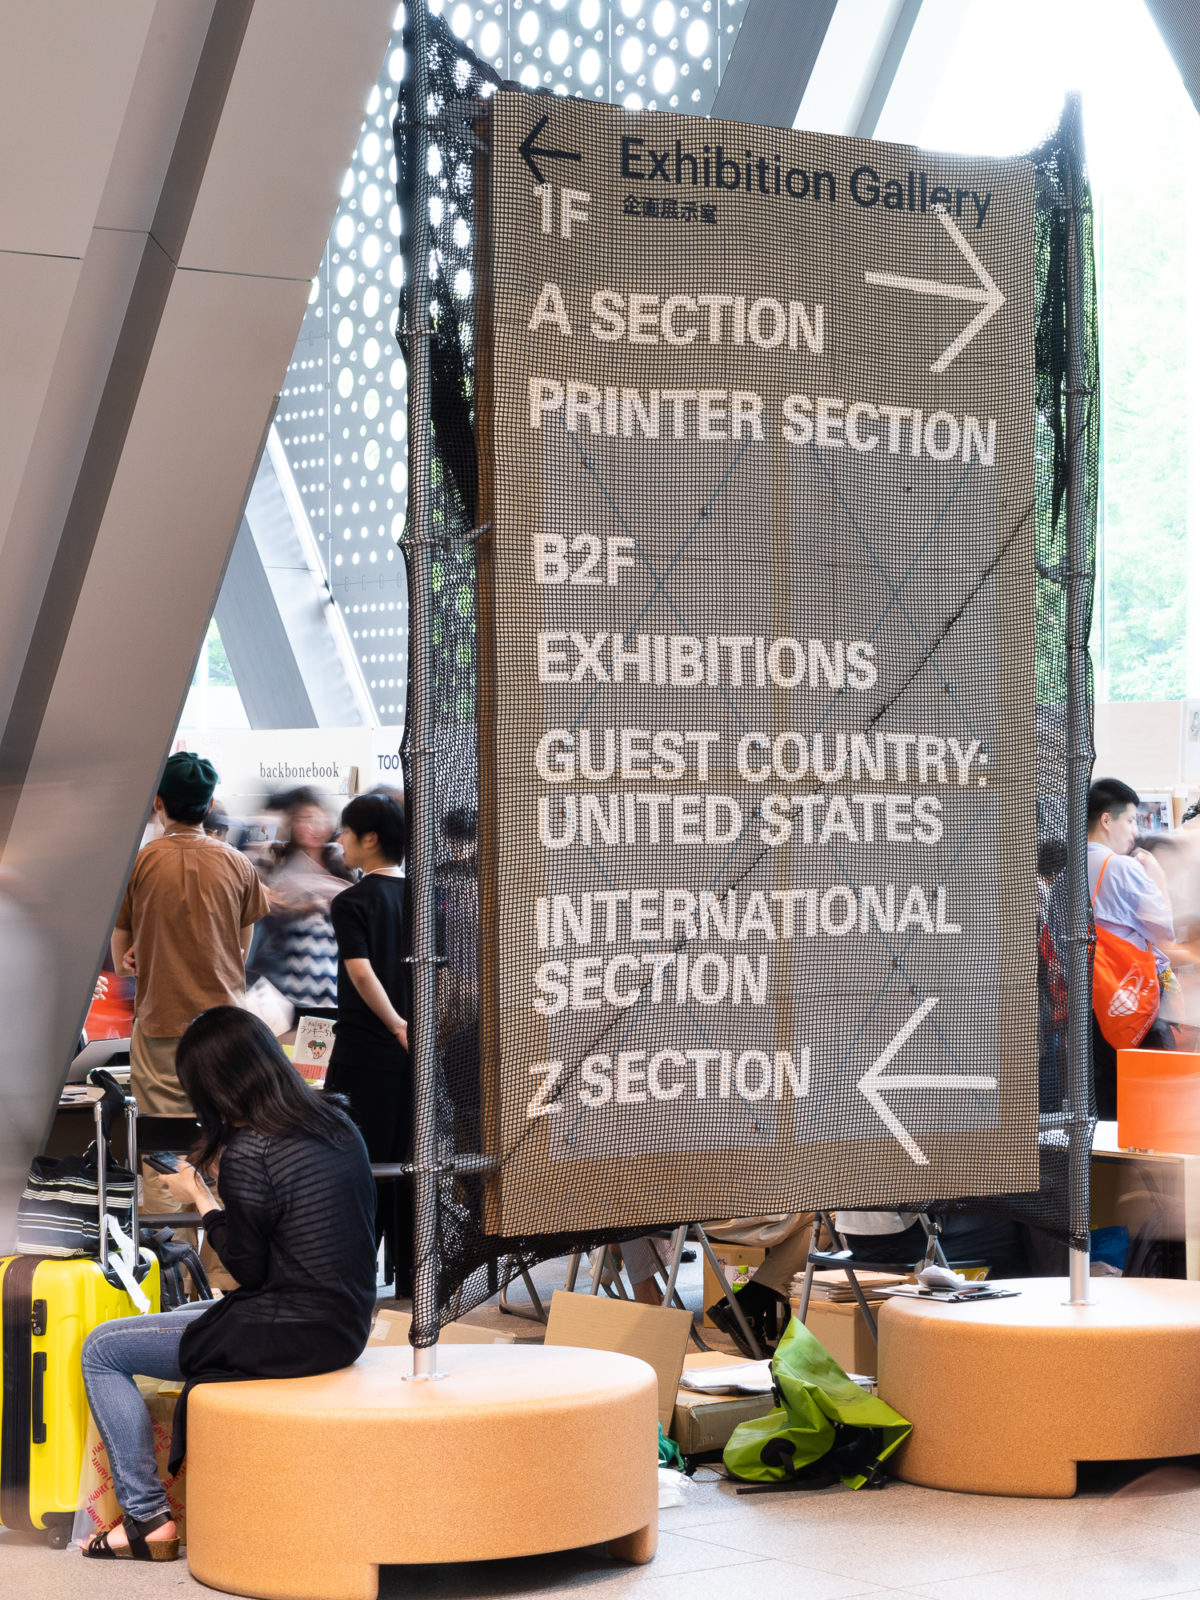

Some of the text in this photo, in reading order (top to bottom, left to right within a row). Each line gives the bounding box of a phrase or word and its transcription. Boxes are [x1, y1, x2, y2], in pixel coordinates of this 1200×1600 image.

[532, 183, 591, 239] 1F
[620, 135, 993, 229] Exhibition Gallery
[623, 194, 718, 225] 企画展示室
[527, 282, 825, 354] A SECTION
[529, 376, 997, 467] PRINTER SECTION
[533, 532, 636, 586] B2F
[536, 631, 878, 691] EXHIBITIONS
[260, 761, 340, 779] backbonebook
[535, 729, 989, 787] GUEST COUNTRY:
[536, 794, 944, 850] UNITED STATES
[536, 884, 963, 949] INTERNATIONAL
[533, 952, 769, 1016] SECTION
[526, 1045, 811, 1119] Z SECTION
